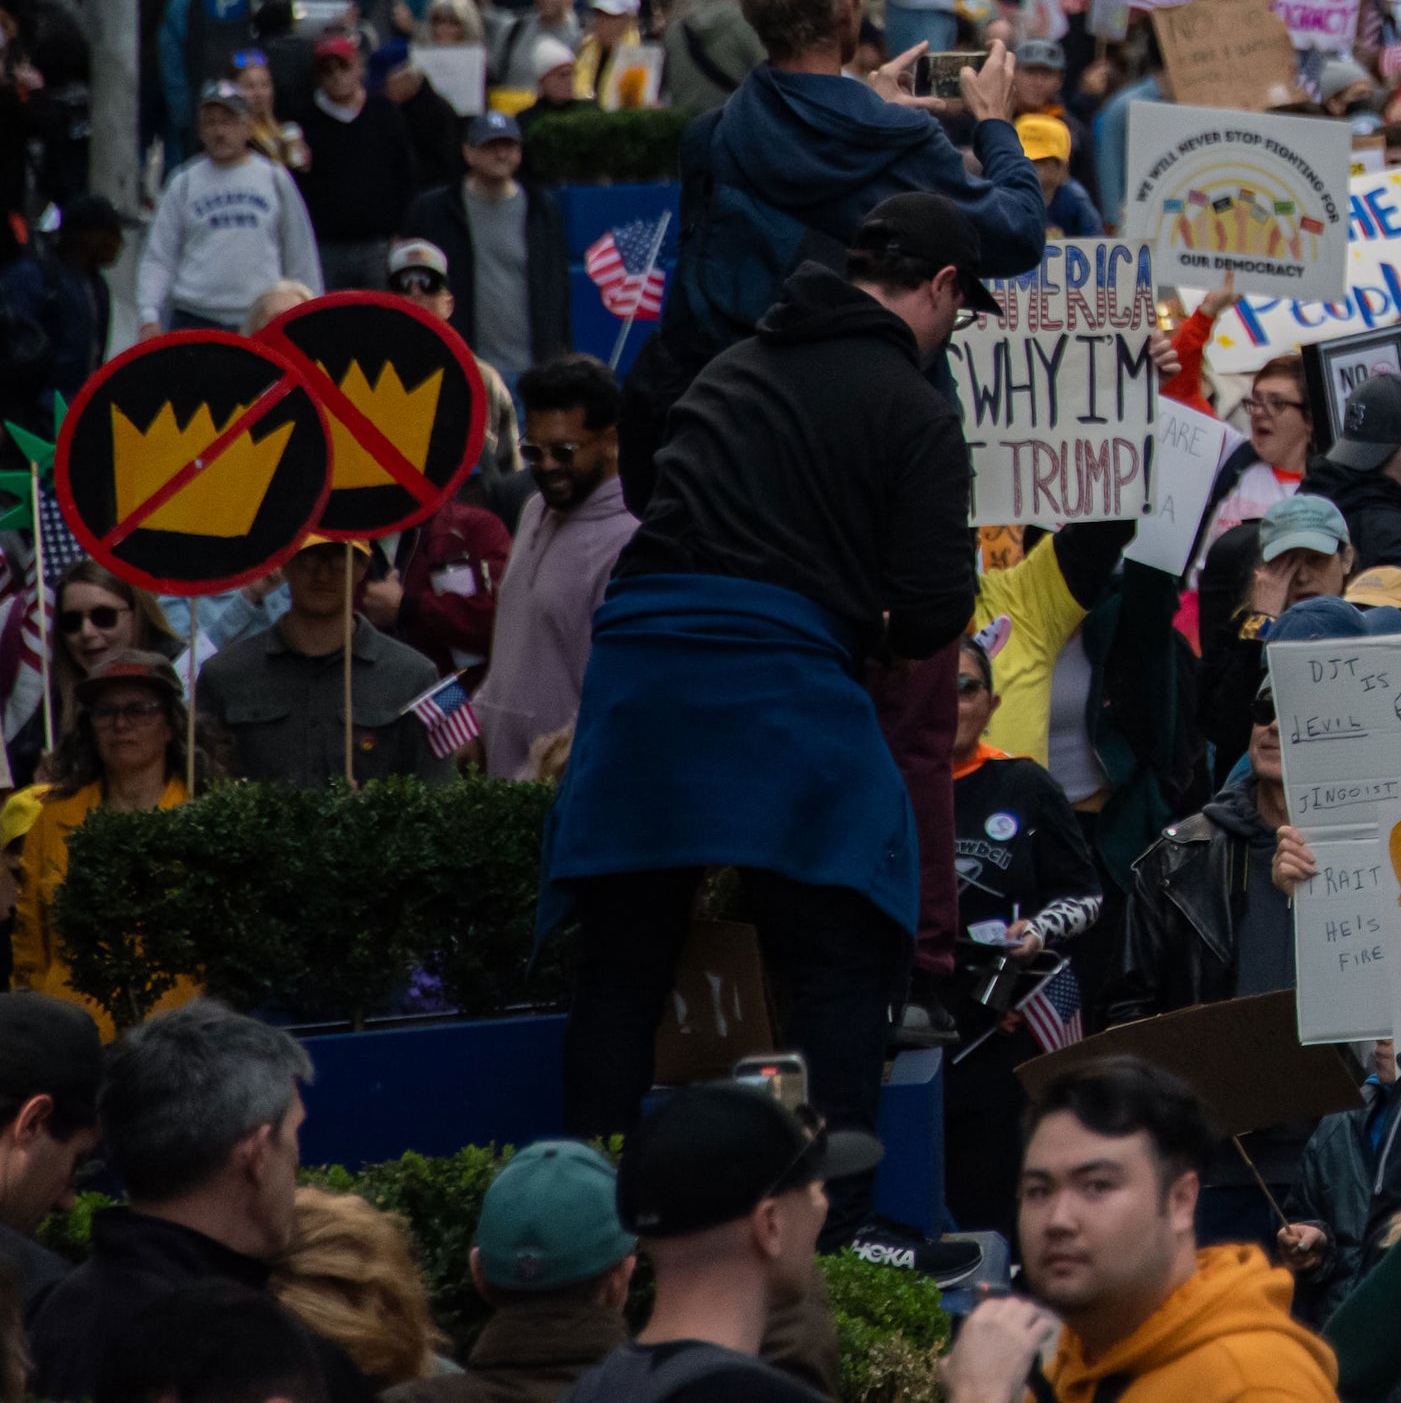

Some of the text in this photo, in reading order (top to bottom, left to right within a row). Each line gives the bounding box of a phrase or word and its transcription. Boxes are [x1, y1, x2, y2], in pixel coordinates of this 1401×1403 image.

[1136, 130, 1341, 225] WE WILL NEVER STOP FIGHTING FOR
[1180, 253, 1306, 279] OUR DEMOCRACY
[1075, 332, 1153, 426] I'M
[1340, 363, 1369, 393] NO
[999, 434, 1154, 520] TRUMP!
[1308, 657, 1391, 693] DJT IS
[955, 839, 1013, 870] wbell
[1304, 864, 1383, 898] TRAIT
[1324, 916, 1382, 943] HE'S
[1338, 945, 1385, 974] FIRE
[854, 1239, 916, 1270] HOKA
